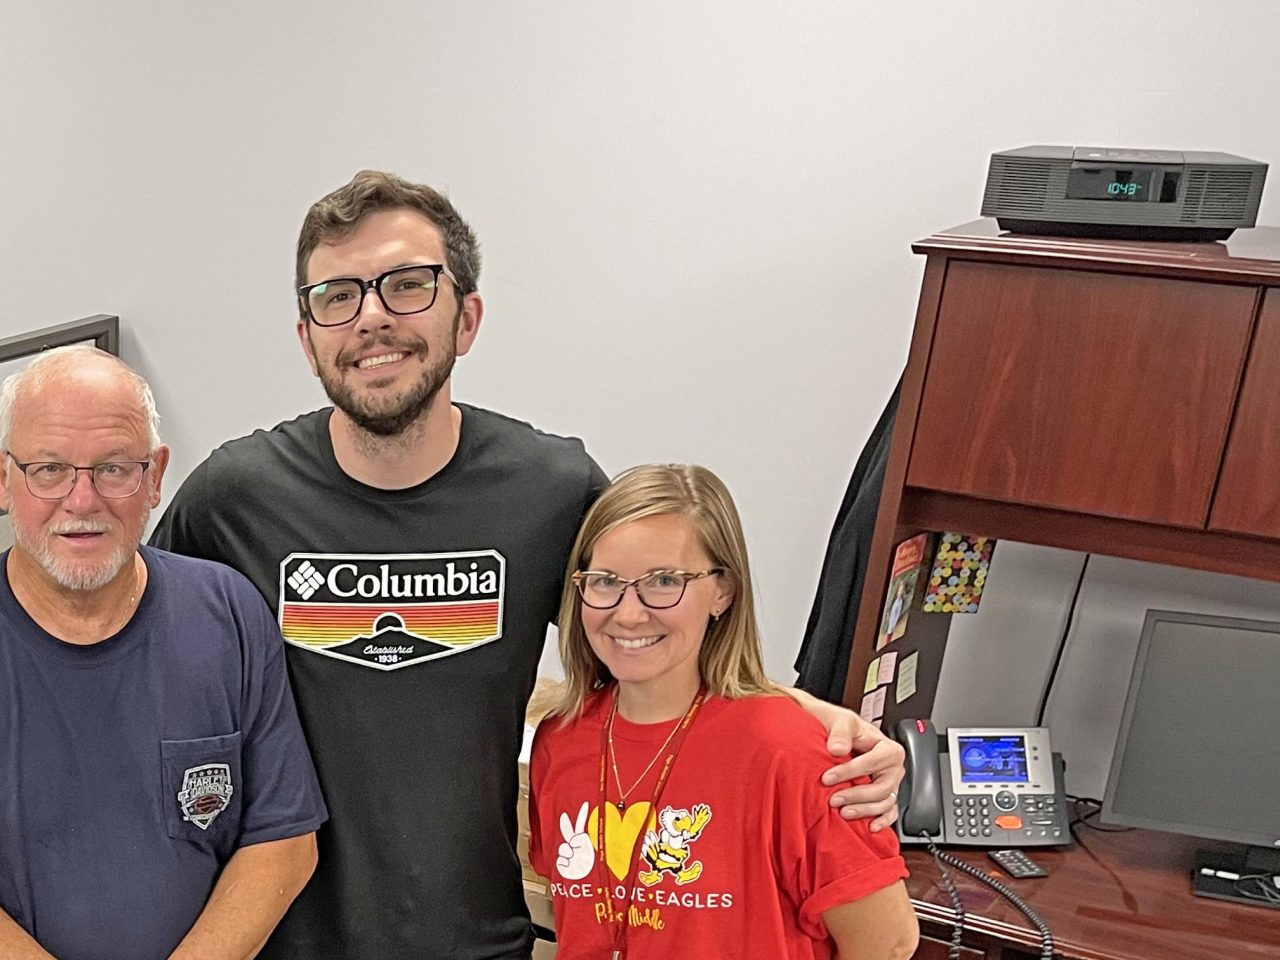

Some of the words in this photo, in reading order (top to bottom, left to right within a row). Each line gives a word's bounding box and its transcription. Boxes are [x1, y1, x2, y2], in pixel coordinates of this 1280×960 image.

[326, 562, 498, 598] Columbia
[363, 645, 415, 655] Established
[378, 654, 398, 664] 1938
[655, 890, 733, 909] EAGLES
[628, 905, 665, 930] Middle
